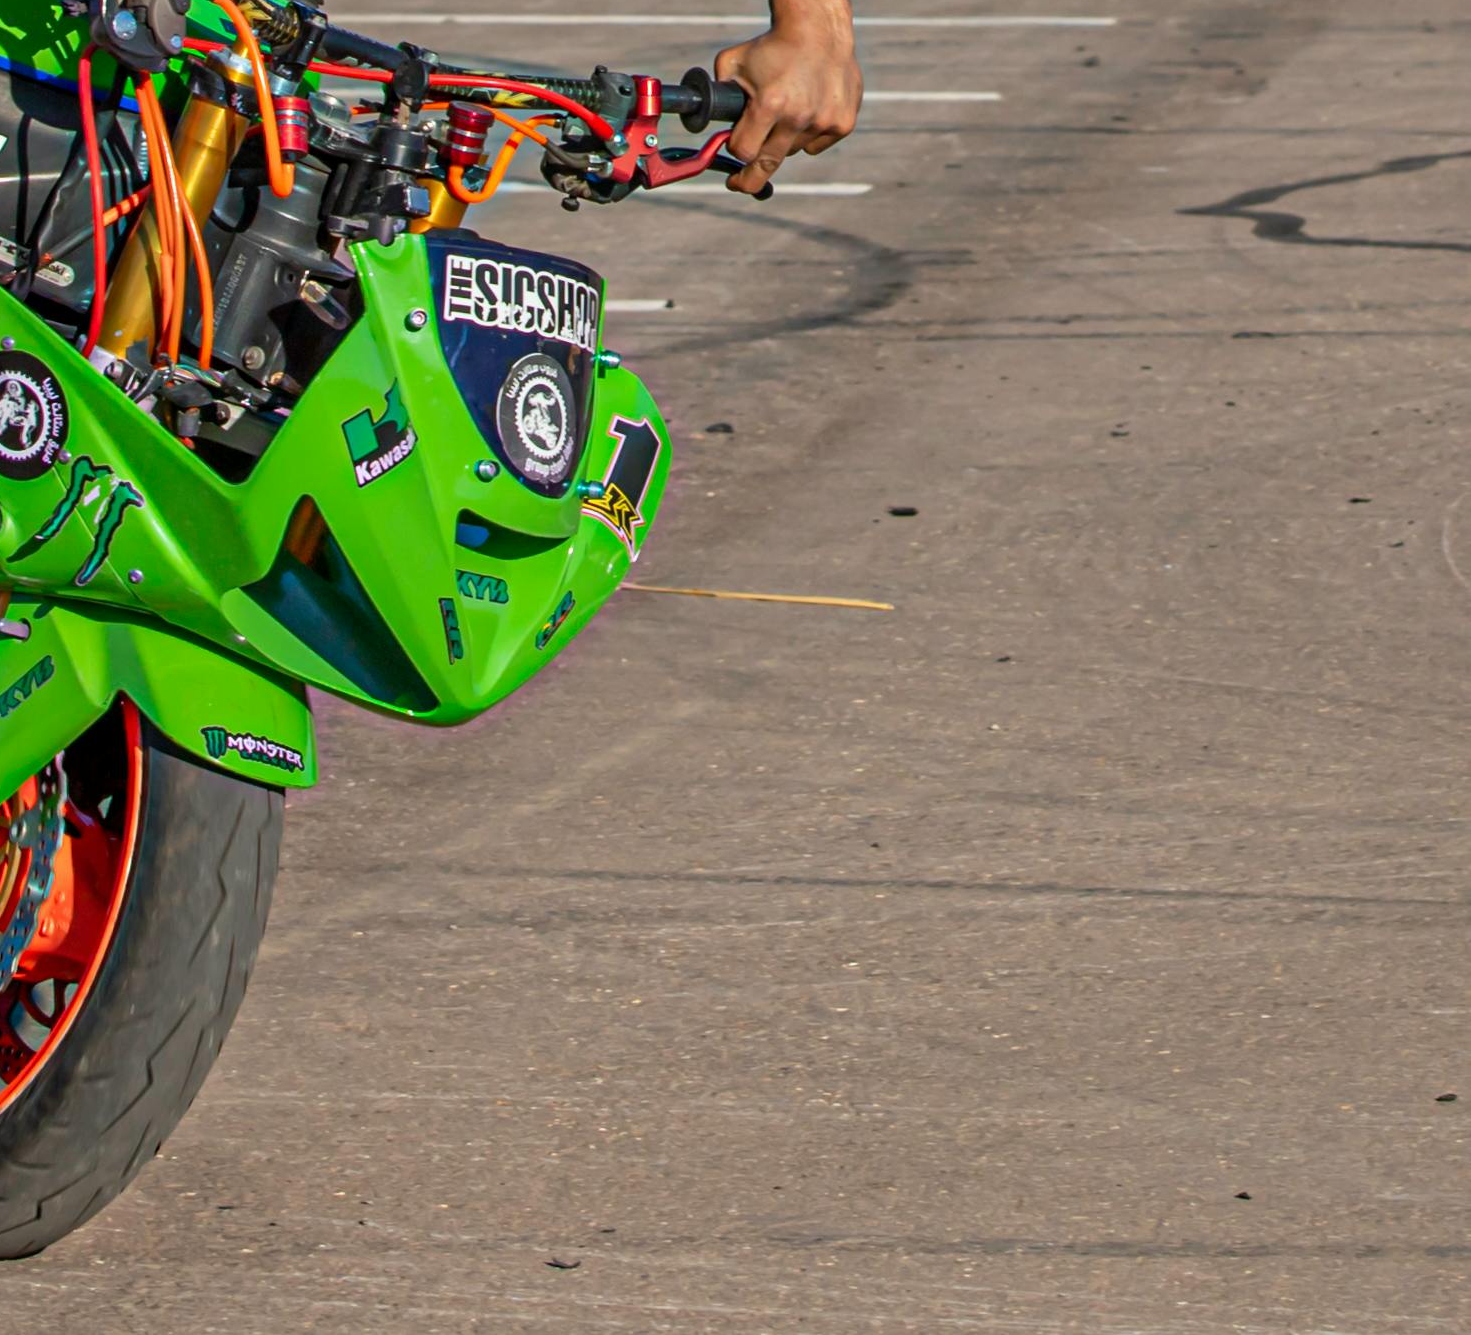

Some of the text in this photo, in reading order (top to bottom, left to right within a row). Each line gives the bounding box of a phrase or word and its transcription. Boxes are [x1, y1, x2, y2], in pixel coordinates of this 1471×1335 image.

[449, 258, 474, 315] THE
[42, 377, 60, 400] ليبيا
[227, 735, 305, 769] MONSTER
